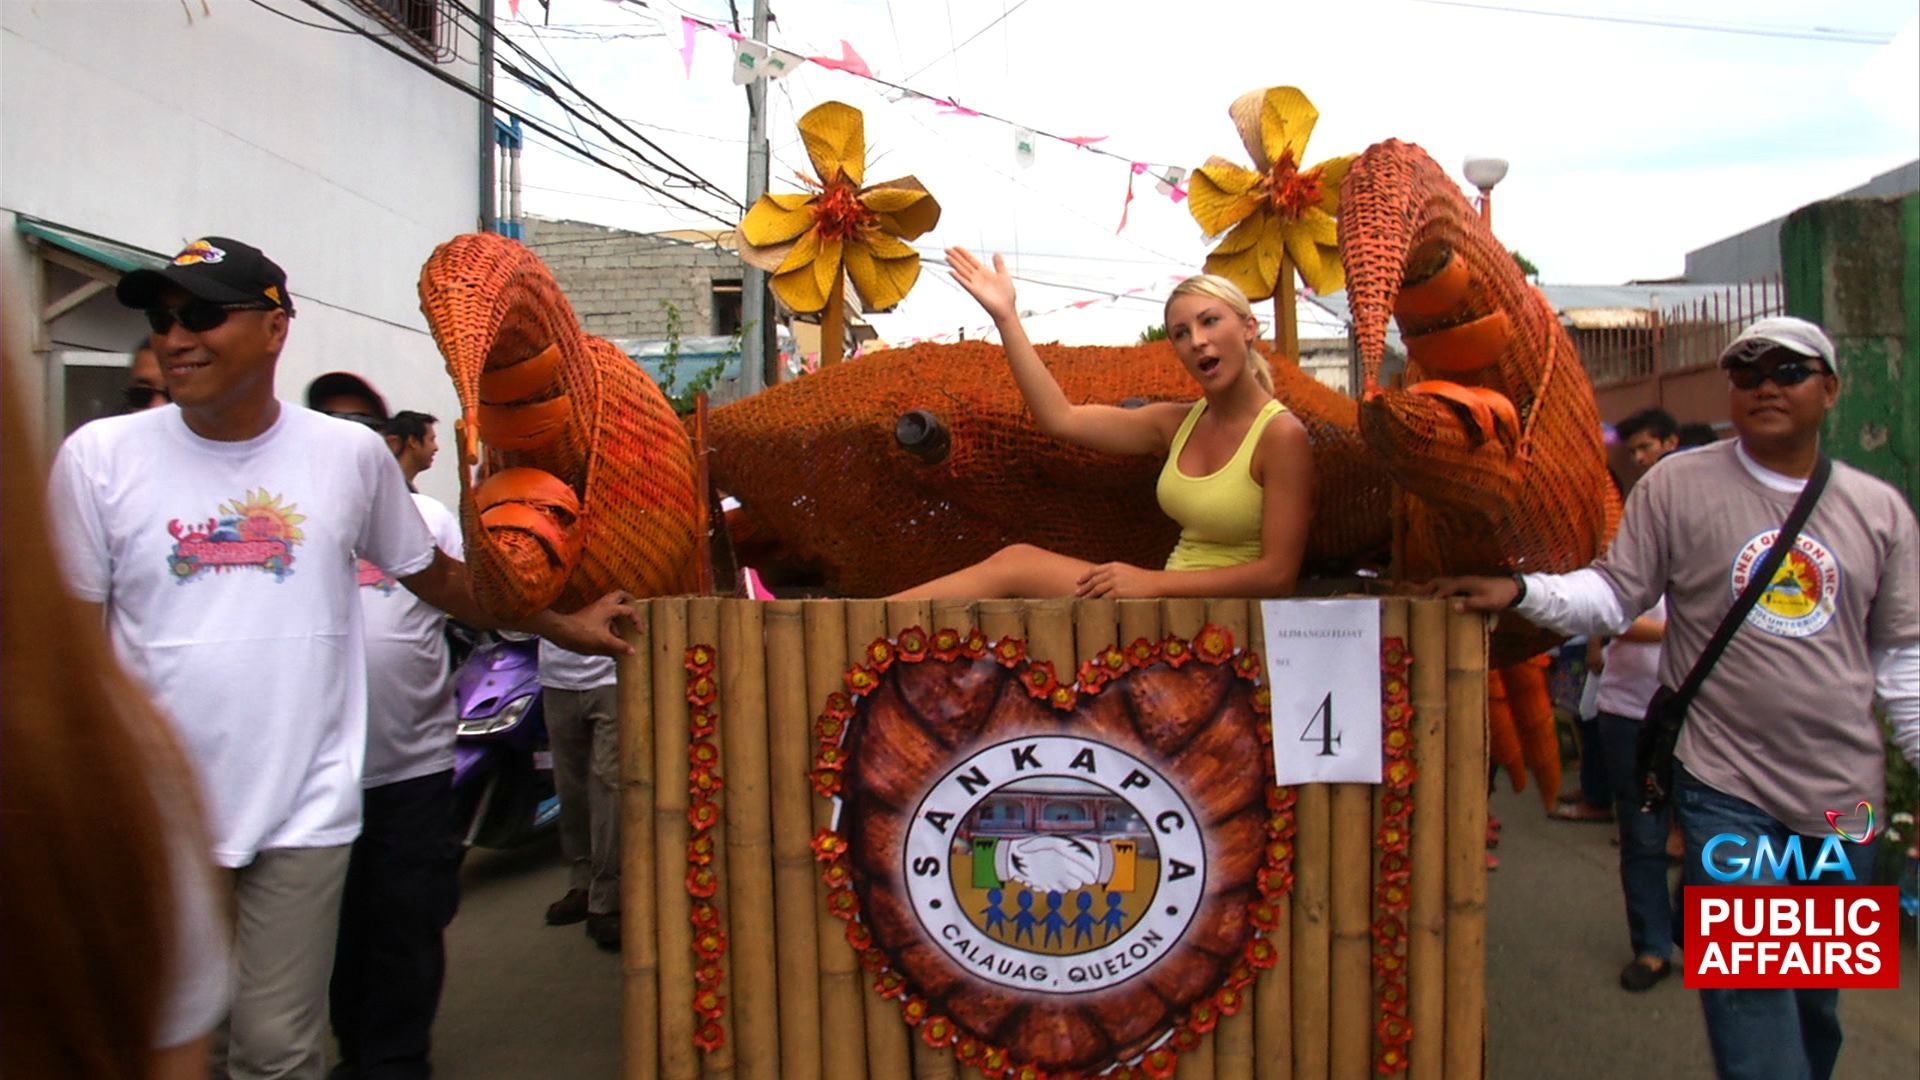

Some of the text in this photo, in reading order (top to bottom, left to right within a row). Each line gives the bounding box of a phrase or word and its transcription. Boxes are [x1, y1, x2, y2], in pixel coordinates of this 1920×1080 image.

[1299, 690, 1342, 757] 4
[913, 744, 1196, 882] SANKAPCA
[941, 924, 1164, 987] CALAUAG, QUEZON
